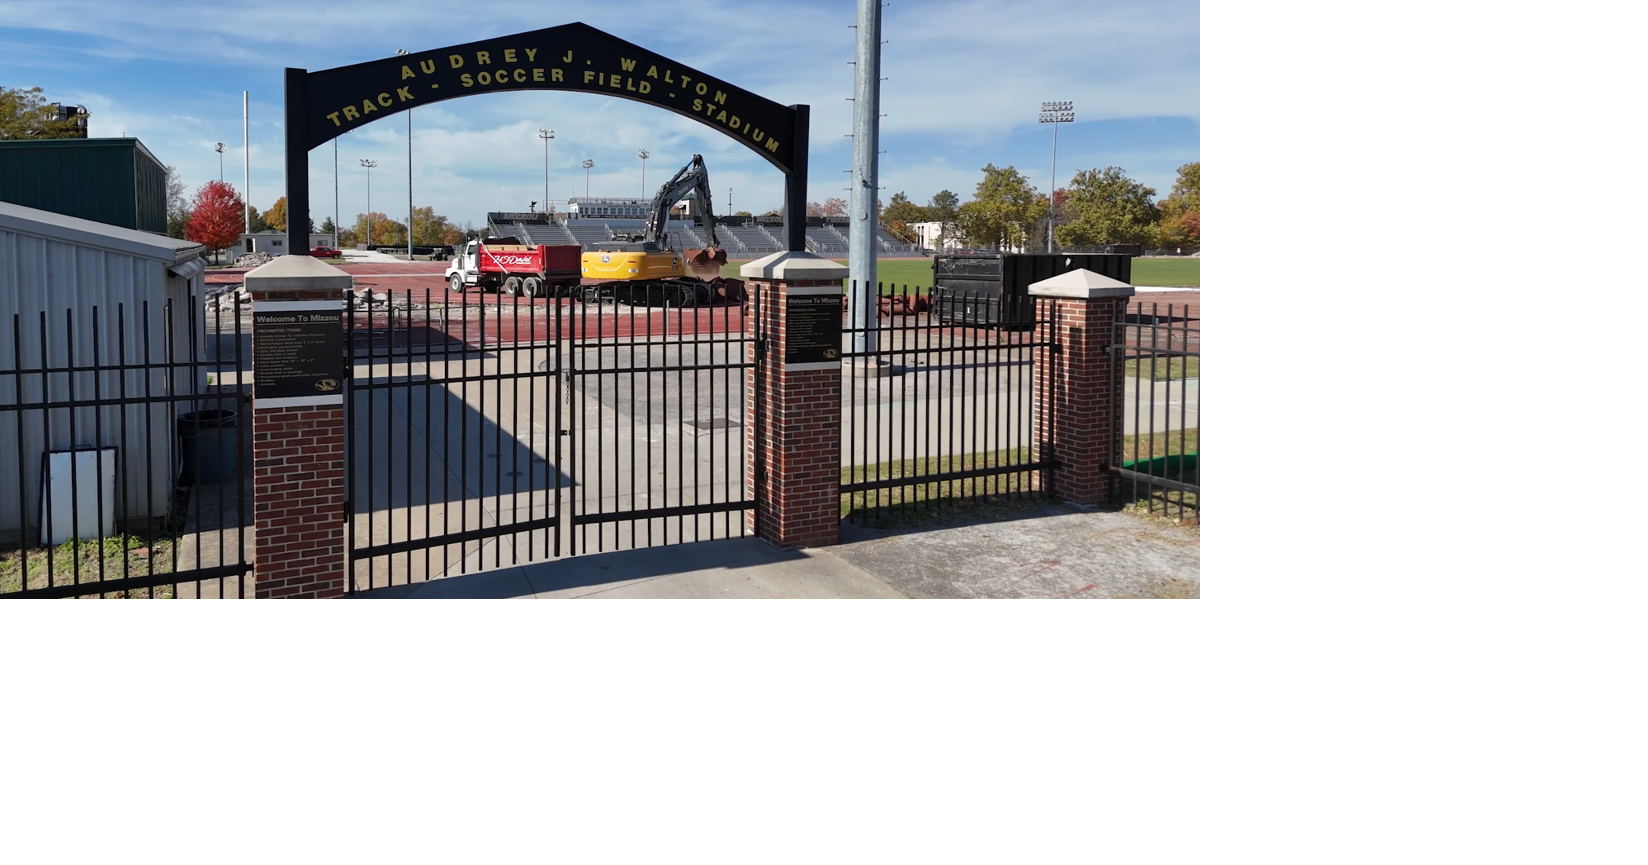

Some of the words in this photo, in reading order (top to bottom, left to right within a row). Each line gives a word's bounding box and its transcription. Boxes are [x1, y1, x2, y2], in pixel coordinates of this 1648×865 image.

[401, 48, 537, 79] AUDREY
[563, 50, 593, 65] J.
[621, 57, 728, 104] WALTON
[326, 86, 415, 127] TRACK
[461, 68, 564, 87] SOCCER
[584, 71, 652, 95] FIELD
[693, 98, 780, 153] STADIUM
[256, 315, 296, 323] Welcome
[297, 314, 309, 322] To
[310, 314, 339, 322] Mizzou
